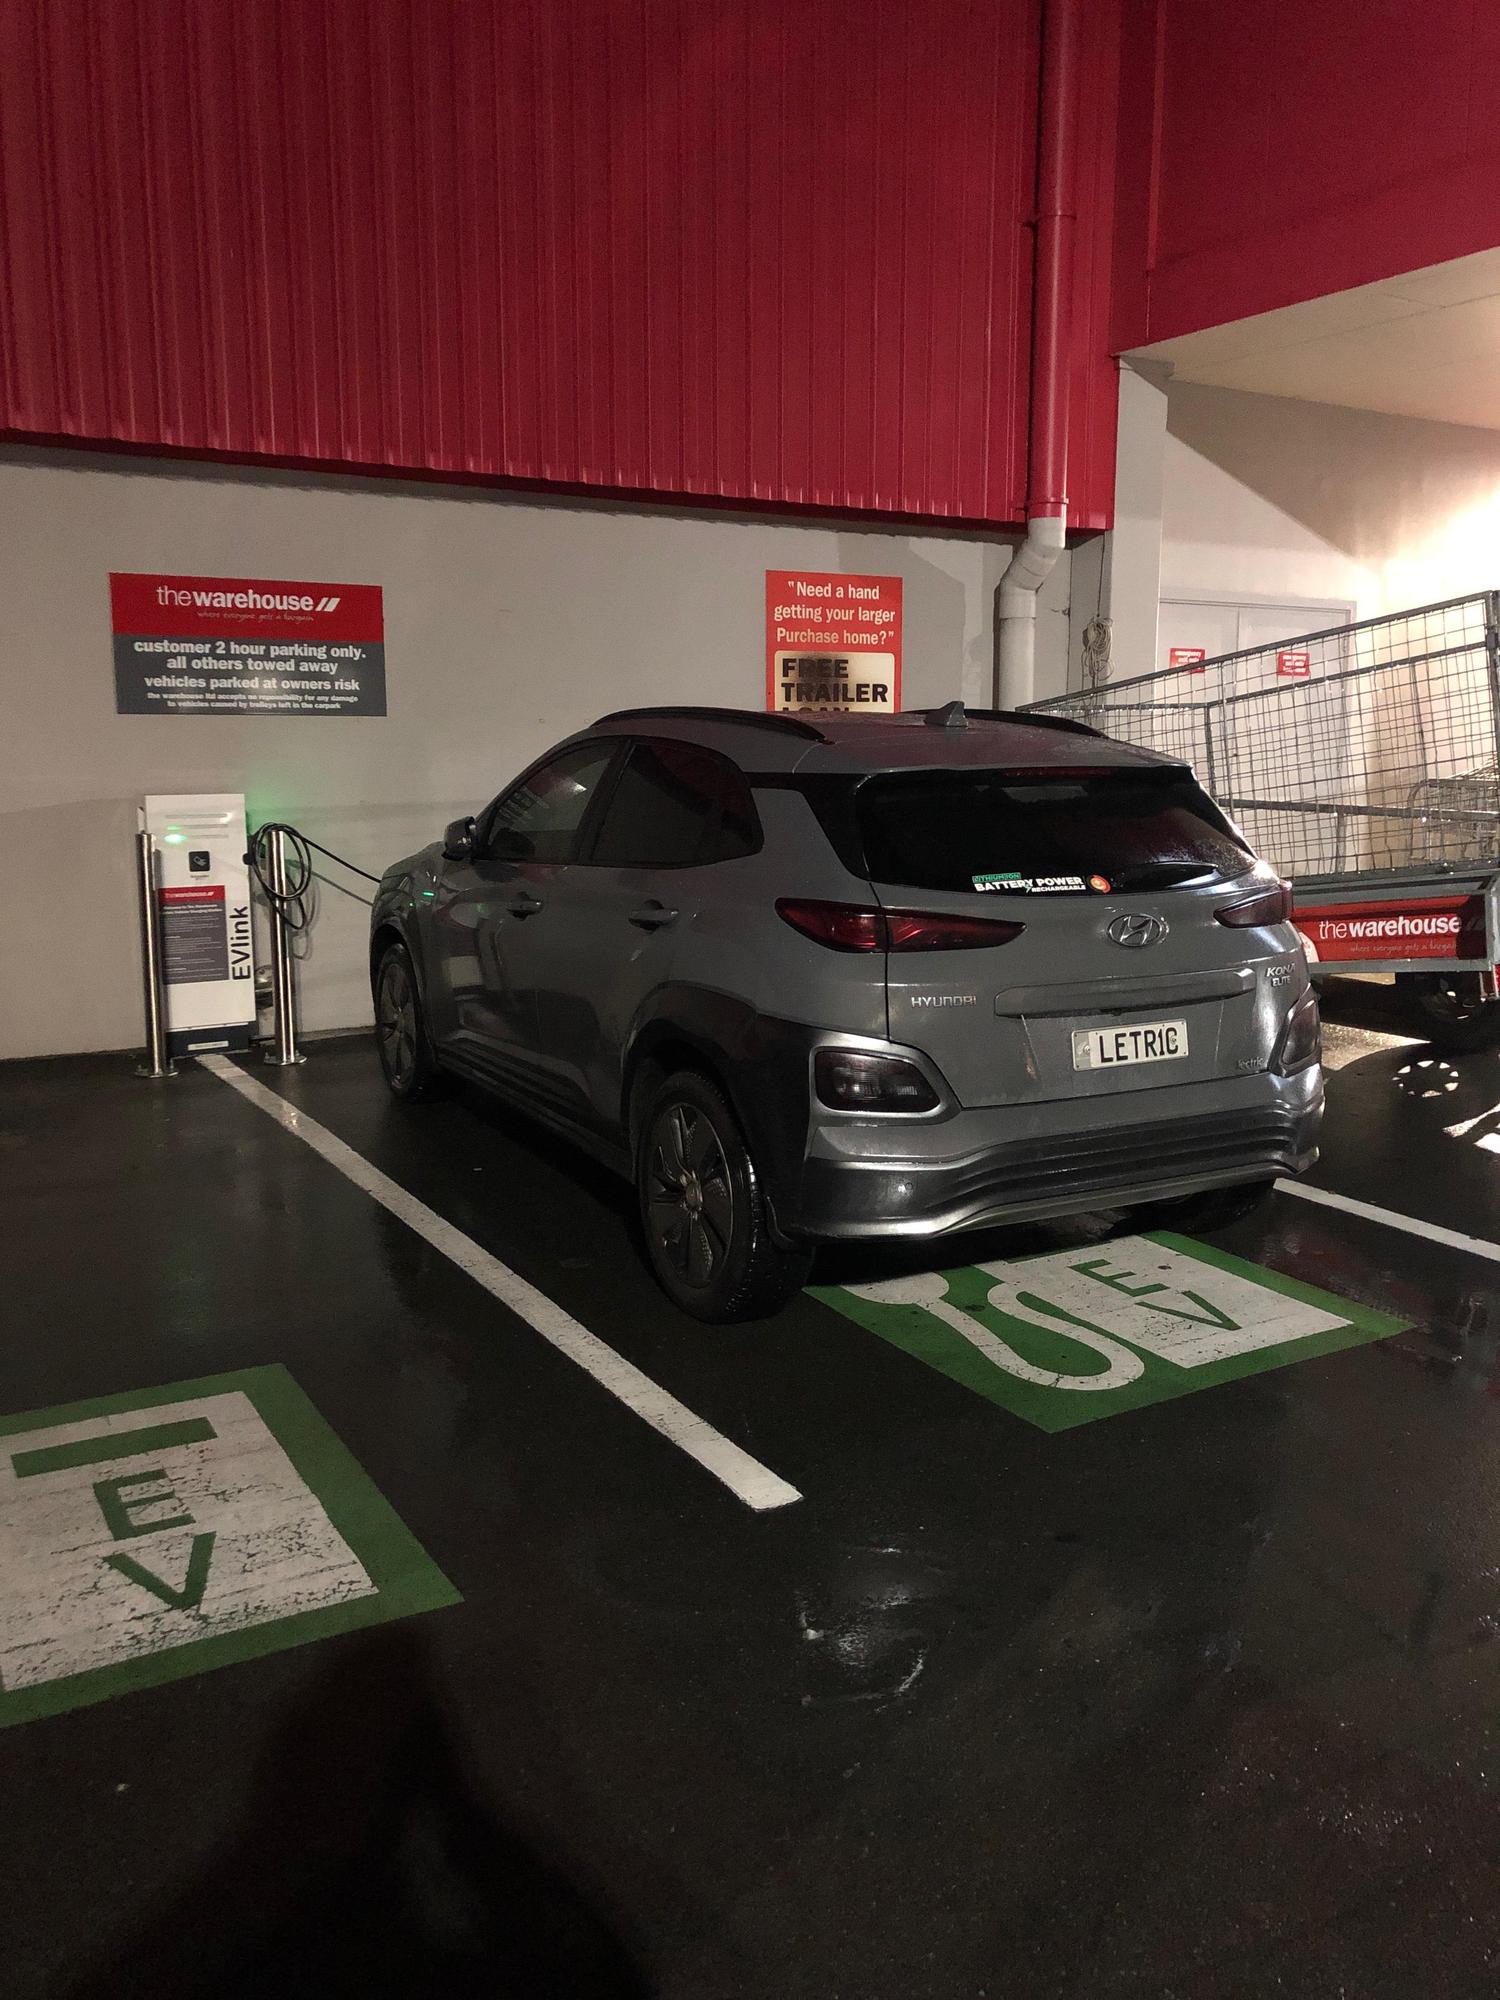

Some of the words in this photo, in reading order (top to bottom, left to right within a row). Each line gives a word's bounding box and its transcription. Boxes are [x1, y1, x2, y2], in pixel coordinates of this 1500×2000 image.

[788, 581, 832, 597] "Need
[836, 587, 844, 598] a
[848, 584, 880, 600] hand
[774, 604, 823, 623] getting
[826, 608, 855, 623] your
[858, 607, 895, 625] larger
[776, 627, 839, 644] Purchase
[843, 630, 895, 645] home?"
[134, 640, 211, 654] customer
[215, 641, 226, 654] 2
[230, 642, 266, 655] hour
[270, 644, 327, 659] parking
[330, 645, 366, 660] only.
[166, 656, 187, 669] all
[191, 657, 243, 670] others
[247, 658, 295, 671] towed
[299, 661, 338, 675] away
[782, 658, 849, 679] FREE
[144, 675, 206, 688] vehicles
[210, 677, 259, 690] parked
[263, 678, 278, 689] at
[281, 680, 331, 690] owners
[335, 679, 360, 691] risk
[781, 683, 888, 702] TRAILER
[974, 879, 1033, 892] BATTERY
[1035, 877, 1084, 887] POWER
[1032, 885, 1086, 893] RECHARGEABLE
[229, 906, 251, 980] EVlink
[1266, 963, 1296, 977] KONA
[1272, 976, 1291, 987] ELITE
[911, 996, 977, 1008] HYUNDAI
